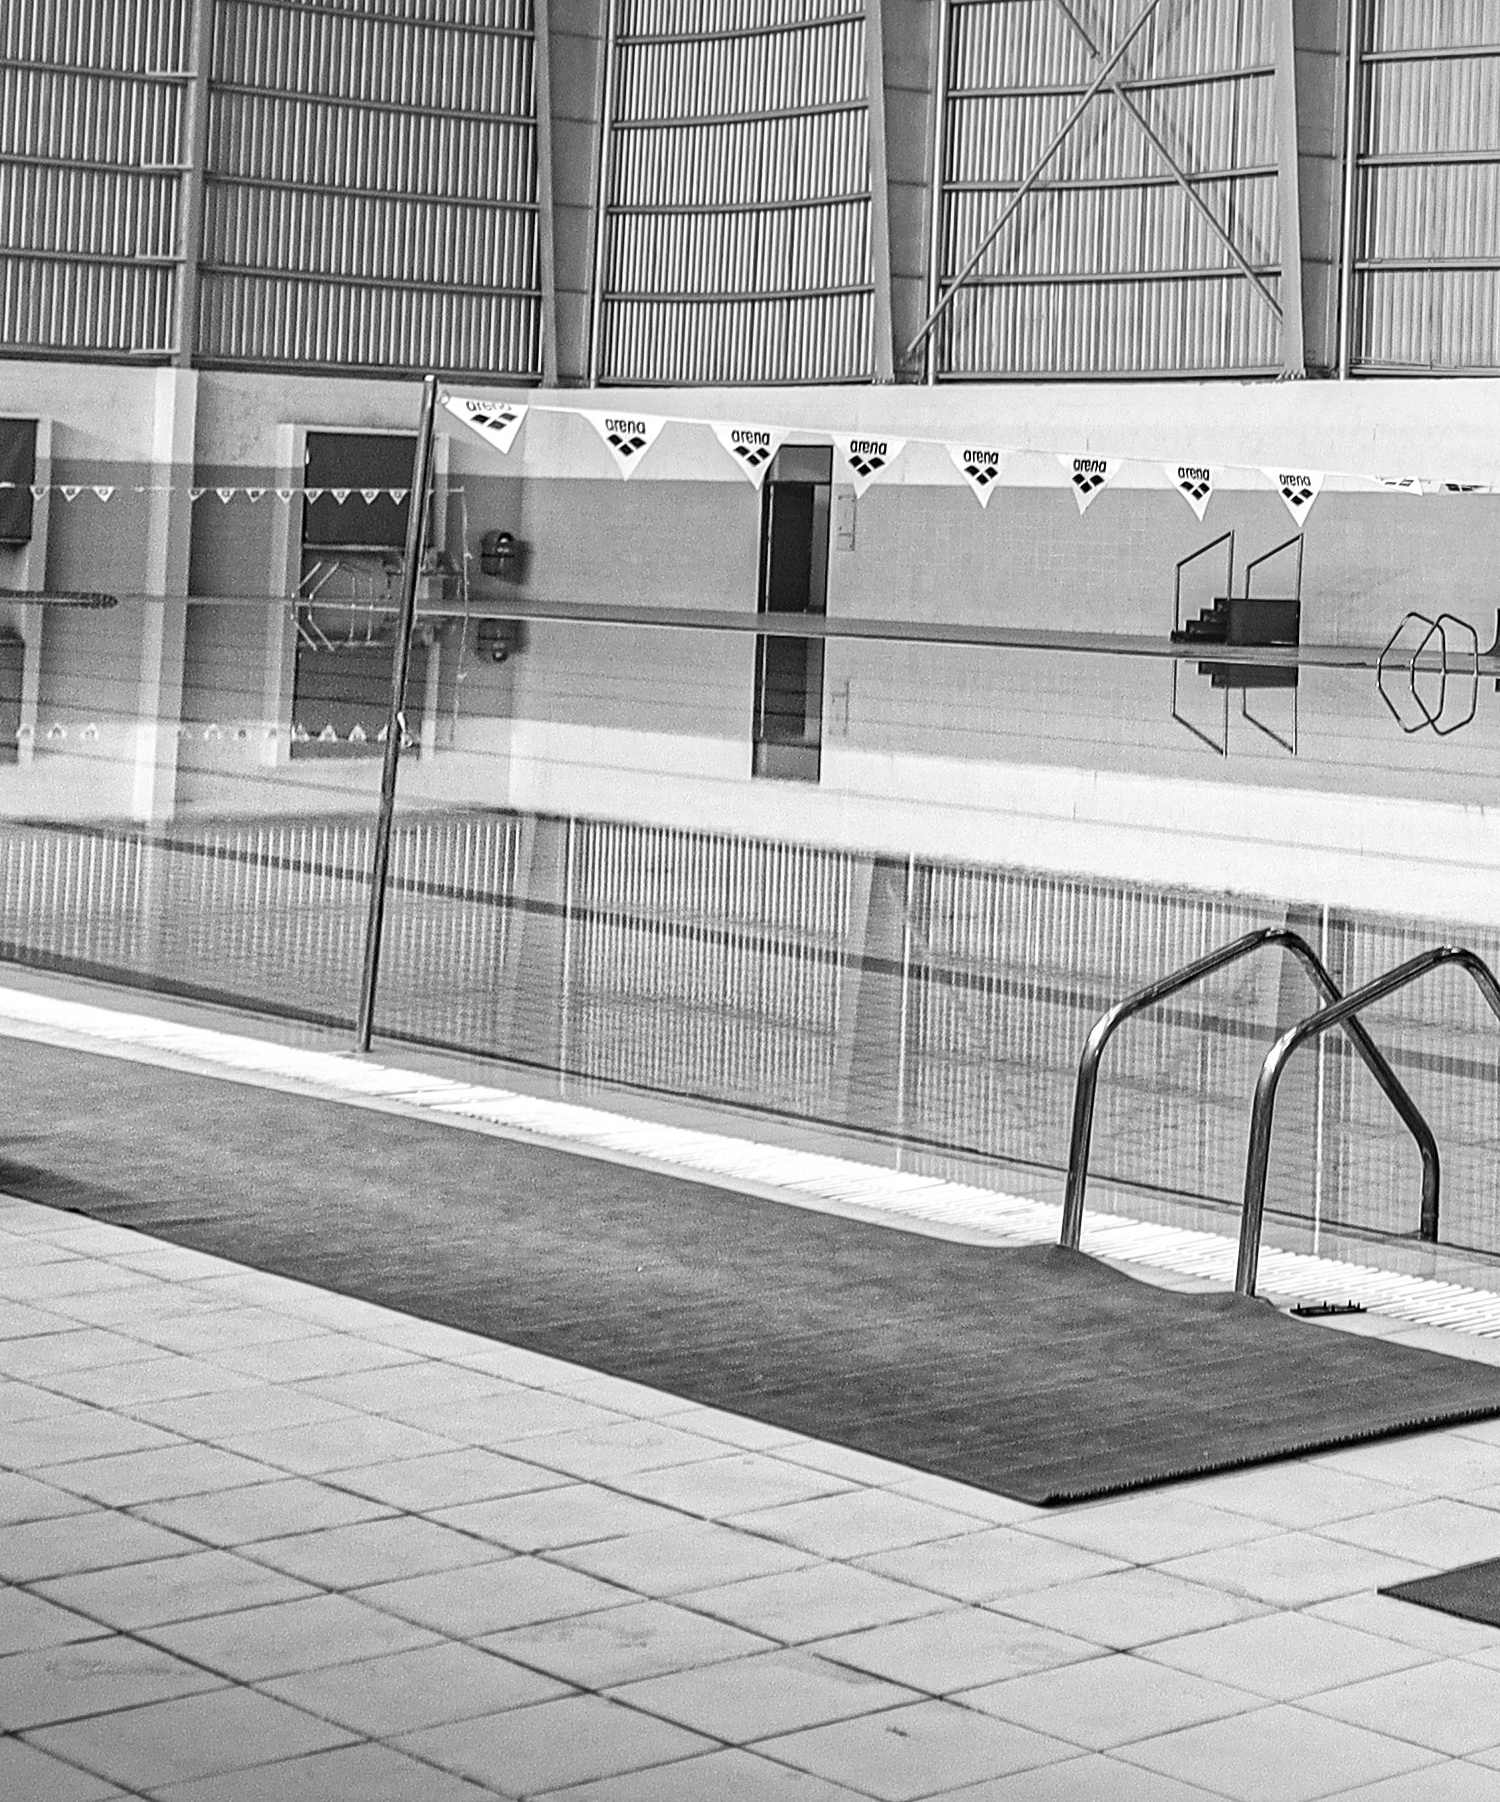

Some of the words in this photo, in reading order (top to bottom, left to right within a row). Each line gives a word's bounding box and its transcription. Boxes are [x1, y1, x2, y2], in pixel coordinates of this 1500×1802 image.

[605, 418, 645, 434] arena
[731, 429, 770, 445] arena
[850, 439, 887, 455] arena
[963, 449, 999, 465] arena
[1073, 458, 1107, 473] arena
[1178, 466, 1209, 481] arena
[1279, 473, 1311, 487] arena
